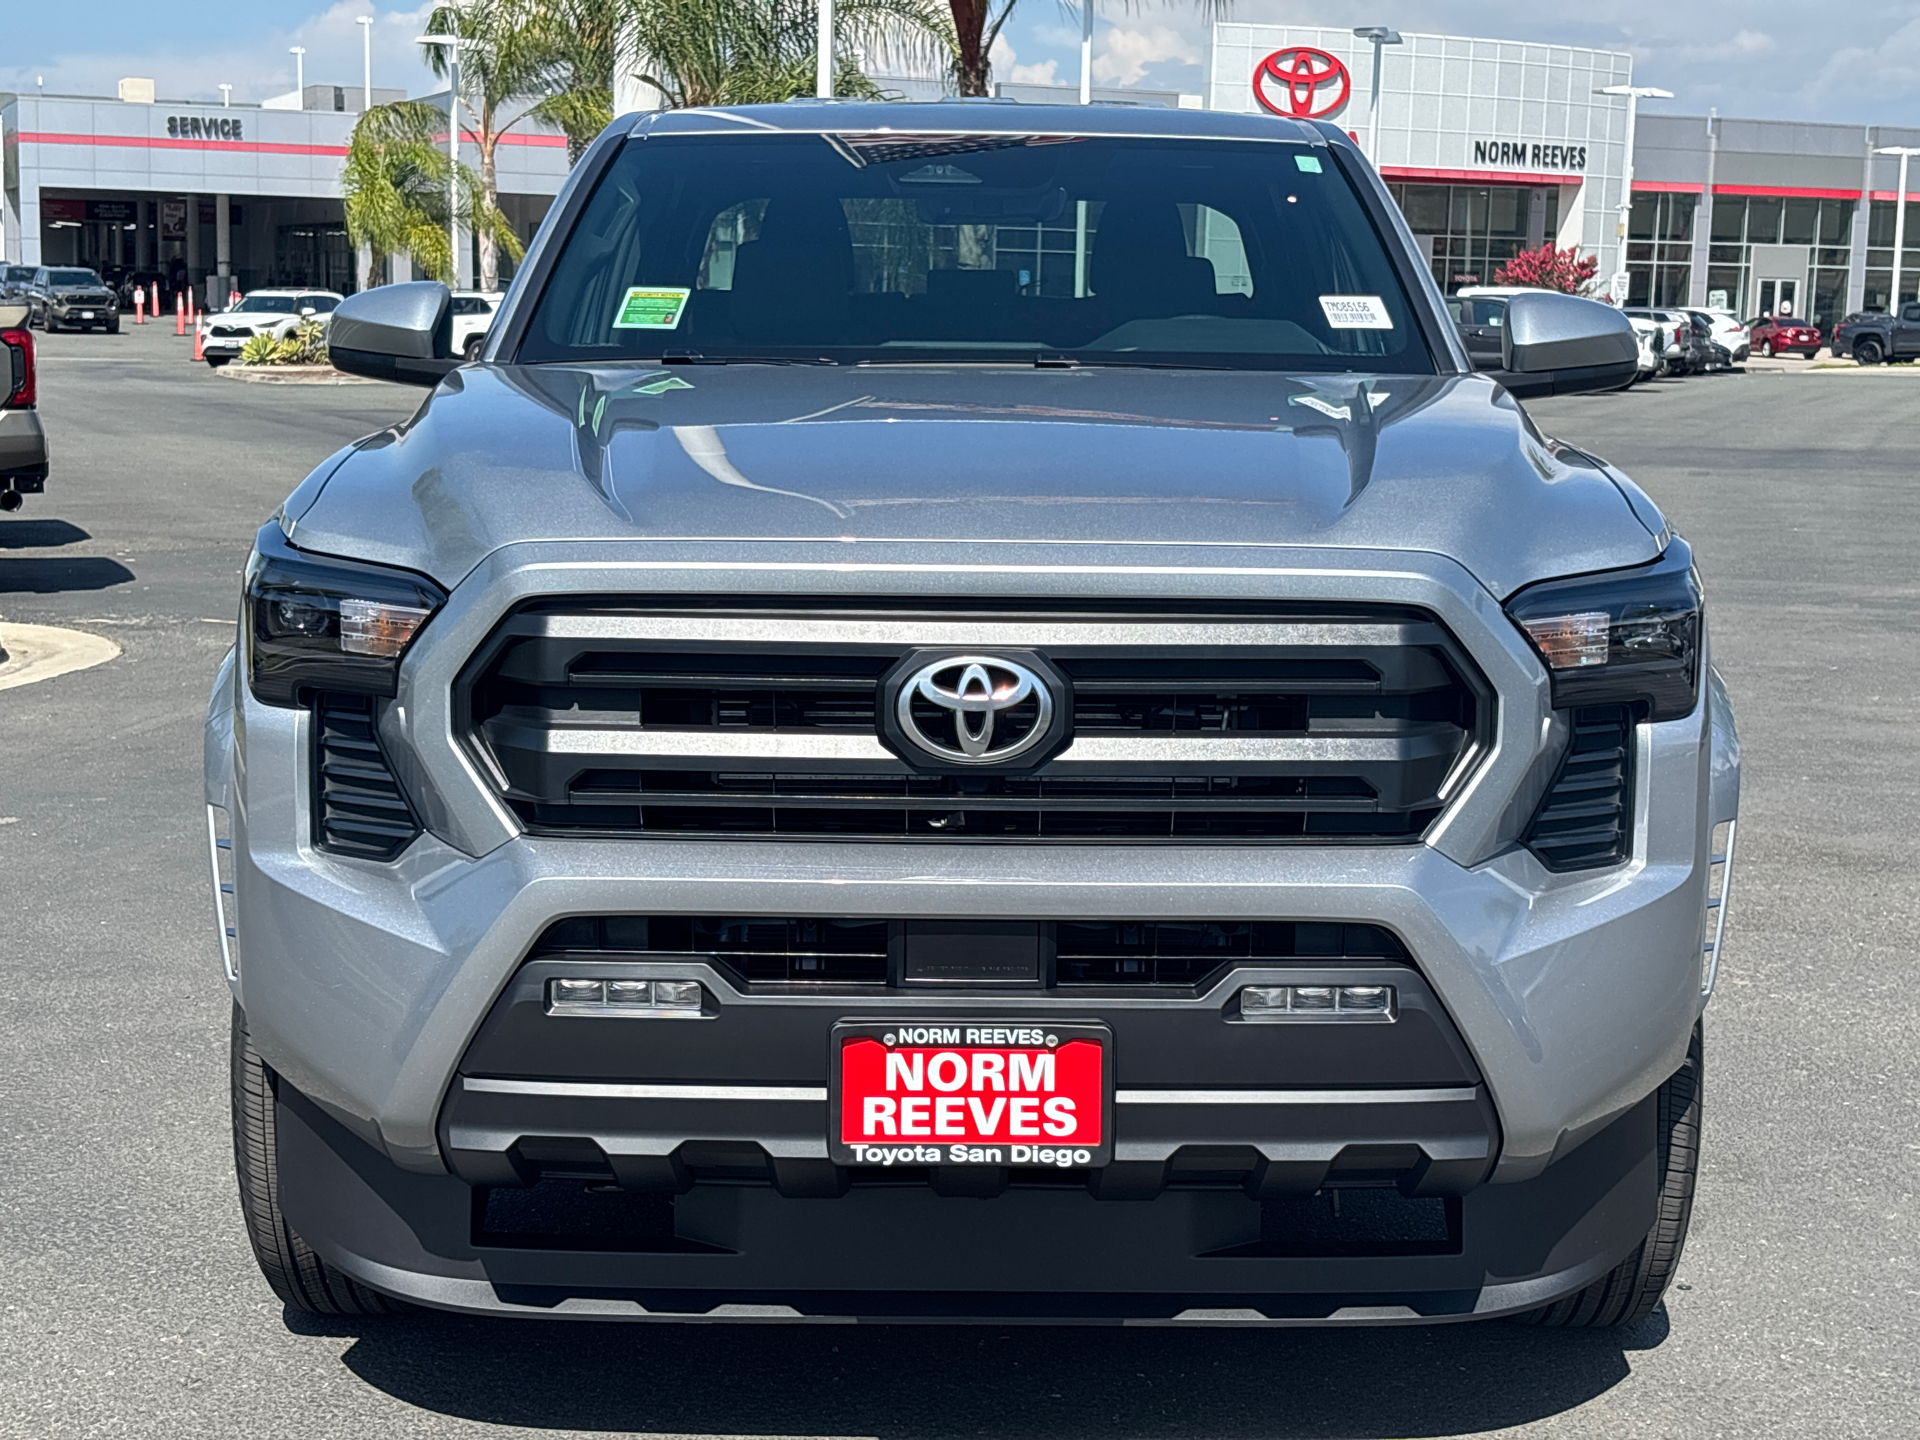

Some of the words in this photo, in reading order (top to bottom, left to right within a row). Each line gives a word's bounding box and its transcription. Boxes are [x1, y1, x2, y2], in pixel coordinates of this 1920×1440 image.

[167, 116, 243, 139] SERVICE
[1474, 140, 1527, 166] NORM
[1531, 144, 1586, 170] REEVES
[1325, 302, 1370, 312] TM085156
[899, 1029, 960, 1044] NORM
[966, 1029, 1044, 1045] REEVES
[885, 1052, 1056, 1092] NORM
[863, 1096, 1078, 1137] REEVES
[850, 1144, 941, 1166] Toyota
[949, 1144, 1001, 1163] San
[1011, 1145, 1091, 1167] Diego
